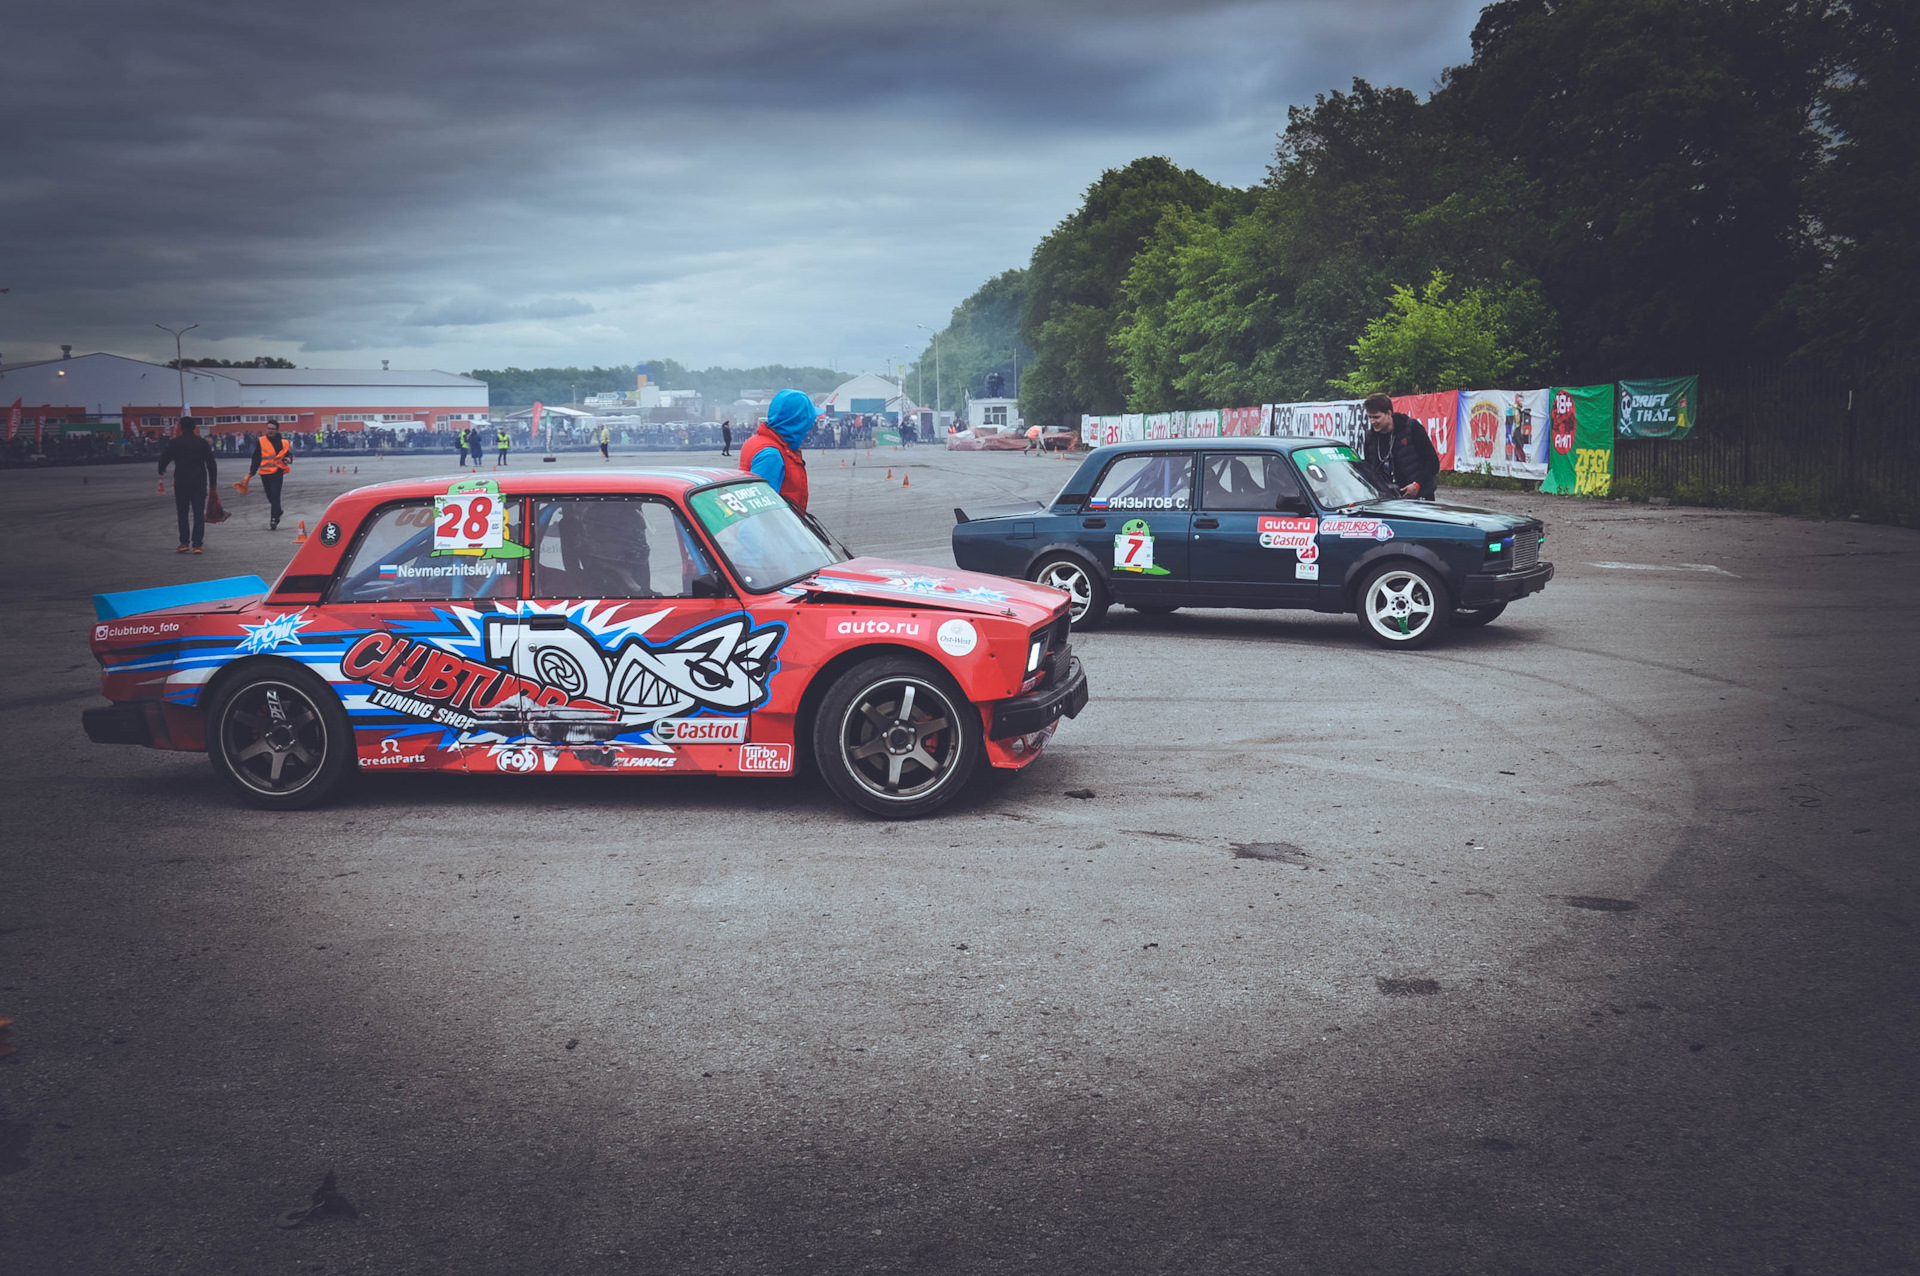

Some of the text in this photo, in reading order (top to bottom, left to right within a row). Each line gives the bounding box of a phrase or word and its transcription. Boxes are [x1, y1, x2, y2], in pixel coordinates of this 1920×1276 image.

[1632, 393, 1669, 408] DRIFT
[1574, 448, 1611, 473] ZIGGY
[734, 486, 762, 501] DRIFT
[1109, 497, 1173, 509] ЯНЗЫТОВ
[436, 496, 492, 540] 28
[1264, 520, 1311, 531] auto.ru
[1322, 520, 1379, 532] CLUBTURBO
[1273, 534, 1310, 546] Castrol
[1124, 538, 1144, 564] 7
[398, 562, 511, 579] Nevmerzhitskiy M.
[109, 622, 180, 637] clubturbo_foto
[252, 621, 294, 645] POW
[837, 619, 920, 635] auto.ru
[372, 688, 434, 720] TUNING
[677, 722, 739, 739] Castrol
[743, 746, 778, 758] Turbo
[745, 756, 788, 769] Clutch
